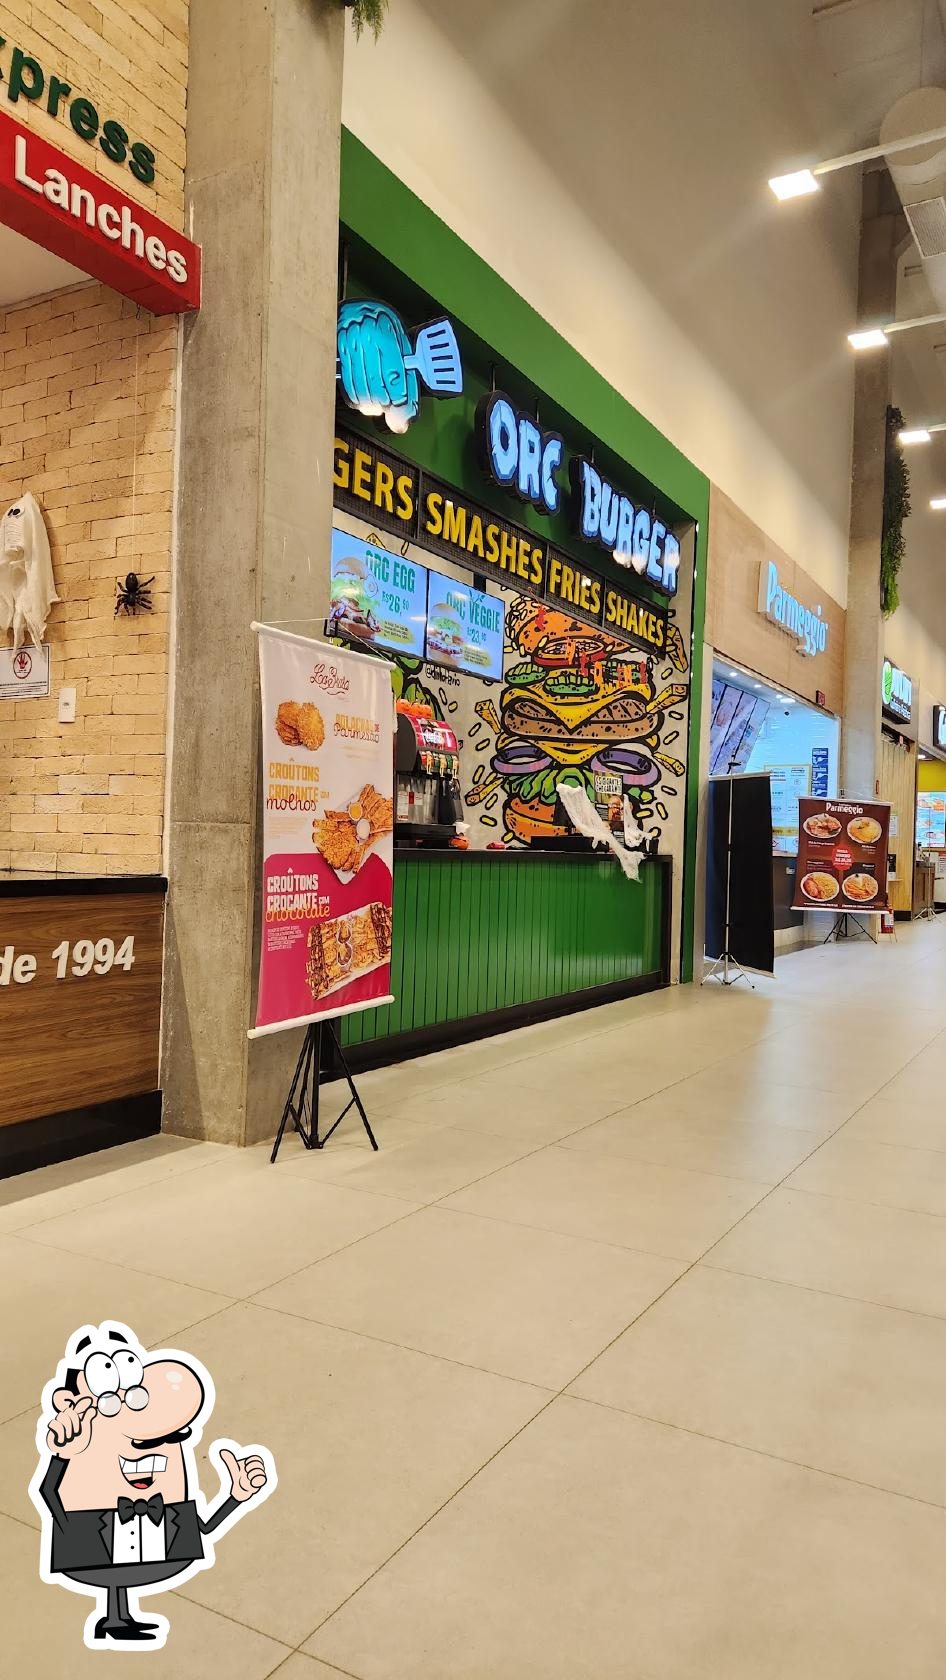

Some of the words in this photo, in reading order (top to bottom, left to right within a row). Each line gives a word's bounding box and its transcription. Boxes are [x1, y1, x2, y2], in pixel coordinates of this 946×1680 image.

[0, 35, 155, 184] press
[15, 134, 189, 284] Lanches
[489, 398, 563, 513] ORC
[582, 460, 680, 593] BURGER
[365, 550, 390, 582] ORC
[392, 560, 416, 594] EGG
[425, 491, 544, 587] SMASHES
[549, 557, 601, 615] FRIES
[606, 591, 664, 647] SHAKES
[469, 600, 501, 634] VEGGIE
[266, 793, 317, 812] molhos
[826, 802, 864, 815] Parmeggio
[265, 904, 331, 923] chocolate
[267, 892, 318, 913] CROCANTE
[52, 935, 136, 979] 1994
